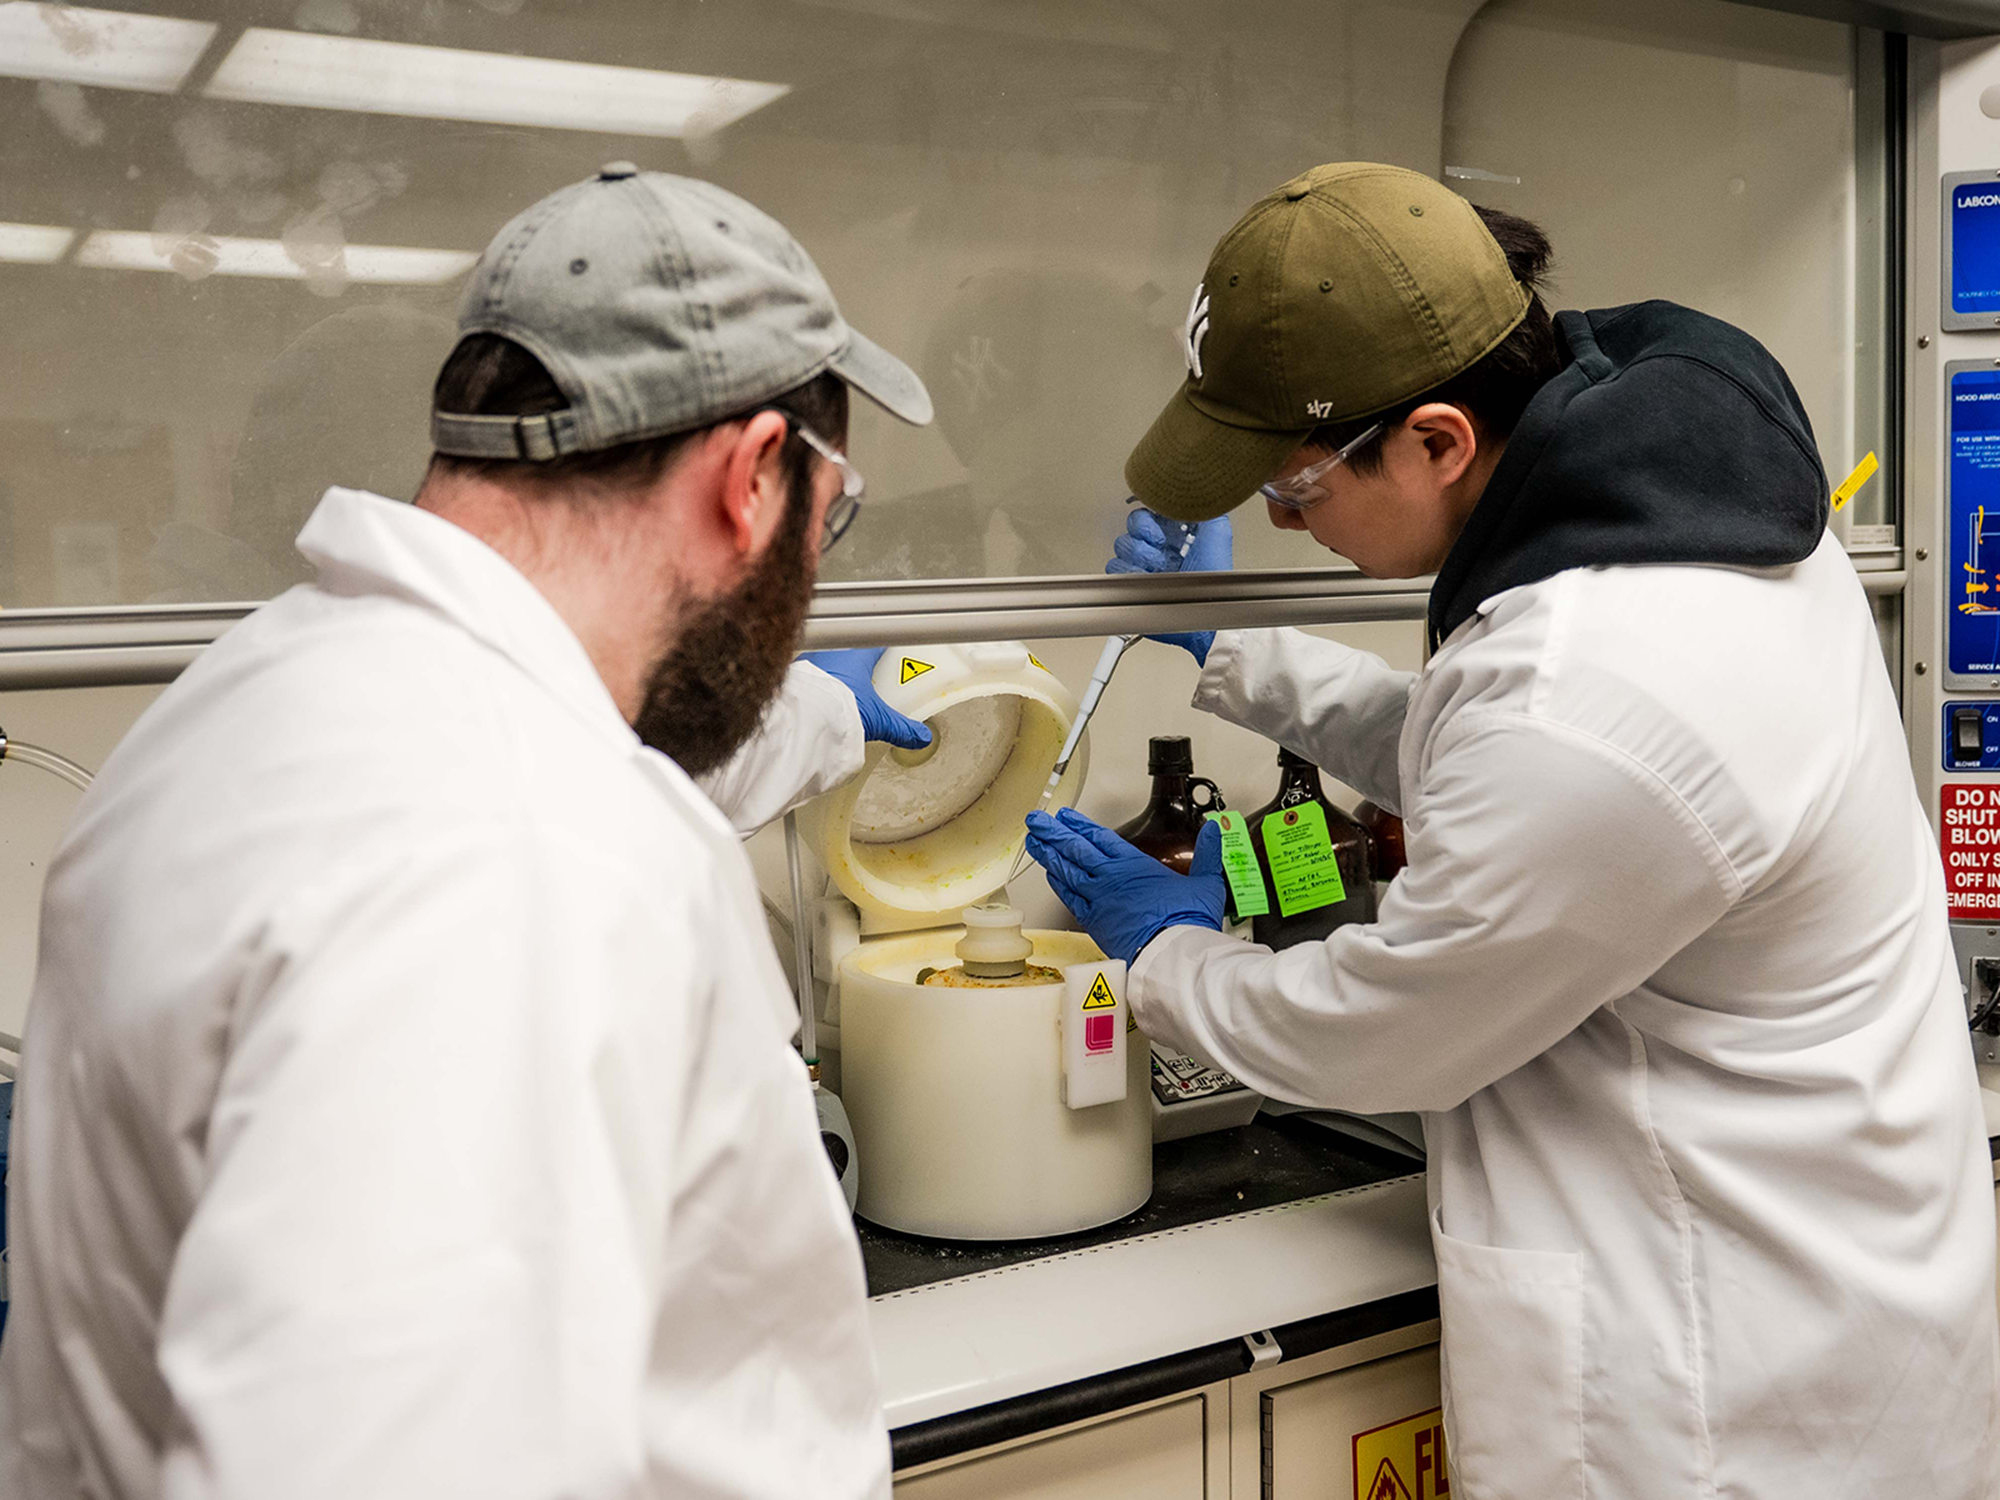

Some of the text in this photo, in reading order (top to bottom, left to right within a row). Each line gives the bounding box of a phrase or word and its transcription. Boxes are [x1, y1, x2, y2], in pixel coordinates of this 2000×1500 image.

[1956, 394, 1978, 402] HOOD
[1968, 663, 1994, 671] SERVICE
[1956, 789, 1985, 806] DO
[1945, 808, 1998, 826] SHUT
[1949, 851, 1990, 868] ONLY
[1955, 871, 1984, 888] OFF
[1414, 1424, 1450, 1500] FL
